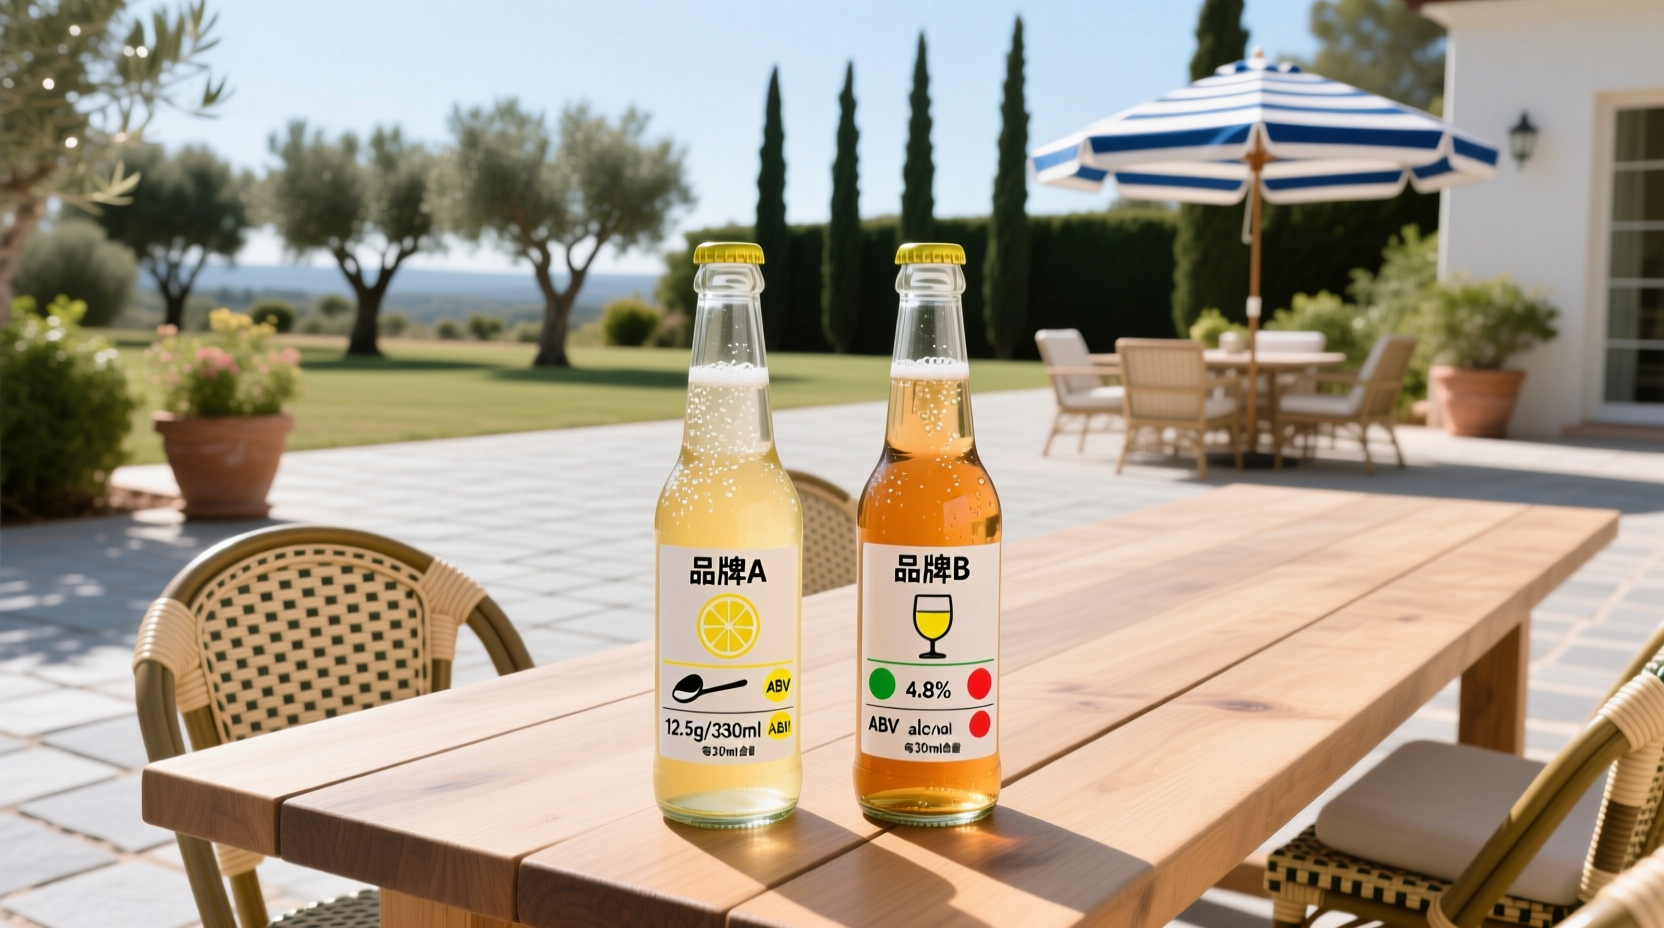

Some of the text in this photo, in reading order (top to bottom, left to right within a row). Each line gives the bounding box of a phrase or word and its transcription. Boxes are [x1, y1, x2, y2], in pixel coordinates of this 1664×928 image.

[689, 556, 767, 586] 品牌A
[894, 554, 970, 584] 品牌B
[766, 678, 791, 694] ABV
[905, 680, 952, 699] 4.8%
[665, 717, 761, 742] 12.5g/330ml
[868, 715, 900, 734] ABV
